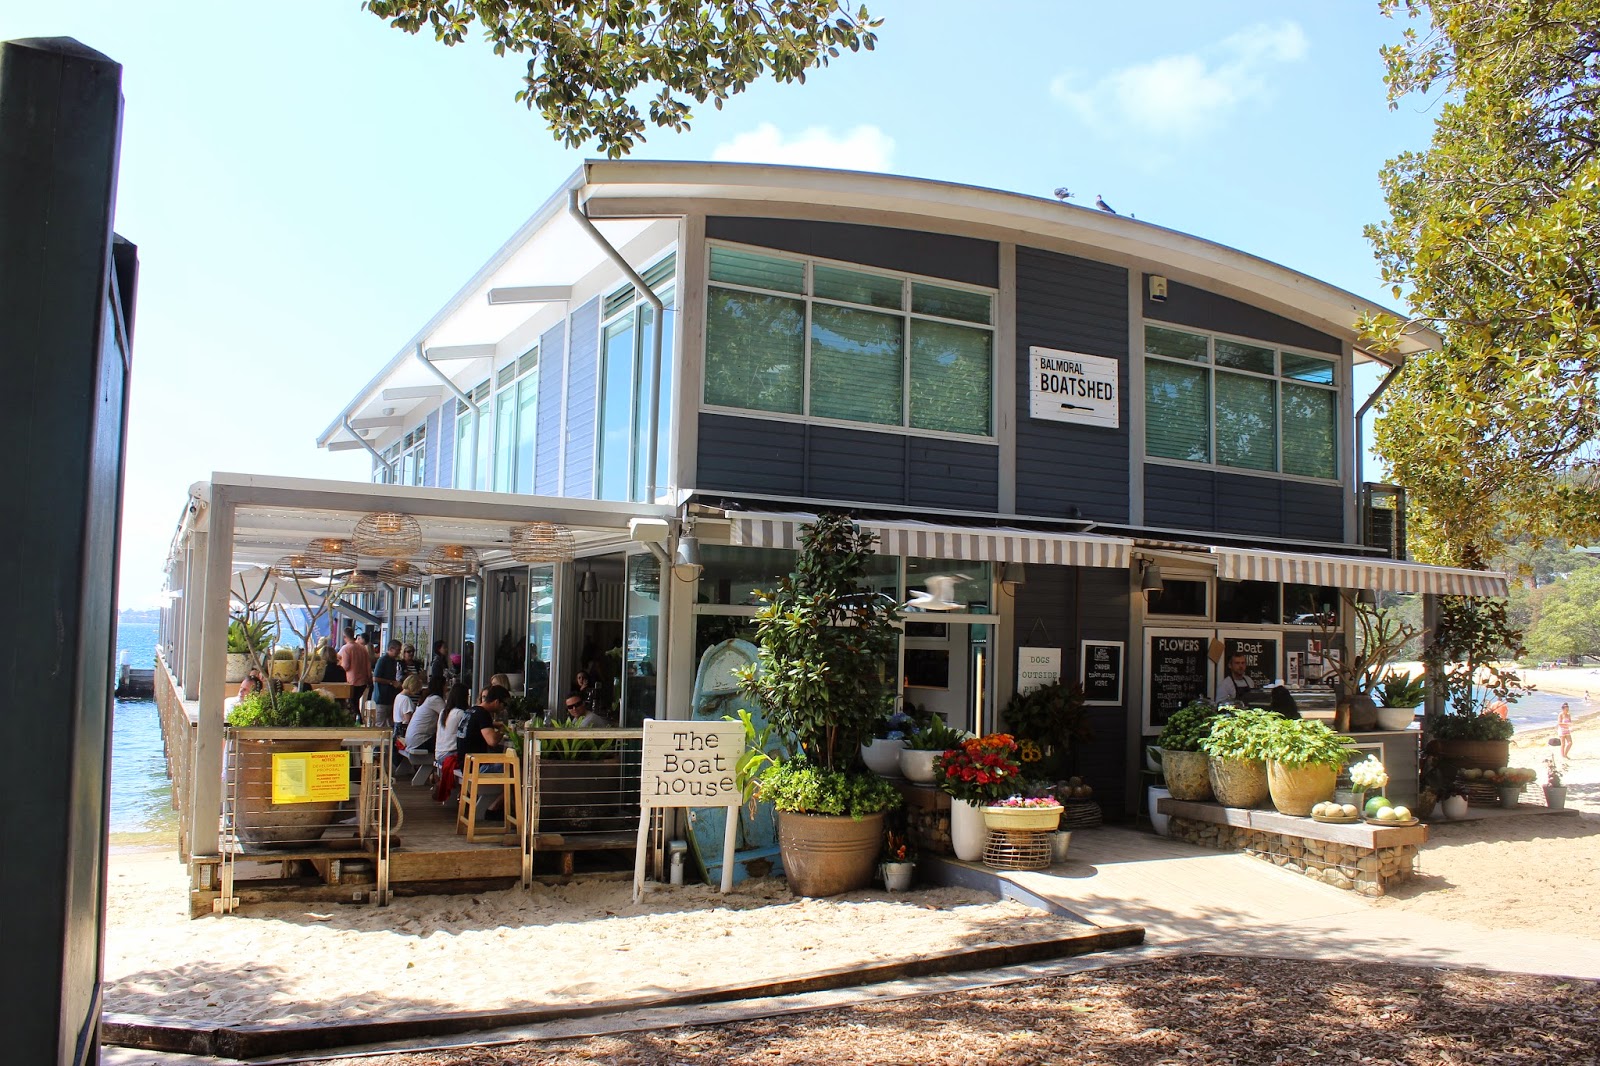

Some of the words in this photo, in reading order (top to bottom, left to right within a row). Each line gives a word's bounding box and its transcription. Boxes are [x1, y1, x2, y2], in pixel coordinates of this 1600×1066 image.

[1040, 357, 1085, 376] BALMORAL
[1040, 372, 1113, 401] BOATSHED
[1158, 639, 1200, 653] FLOWERS
[1030, 656, 1050, 664] DOGS
[1021, 671, 1058, 680] OUTSIDE
[673, 731, 719, 751] The
[663, 753, 726, 774] Boat
[654, 775, 734, 797] house
